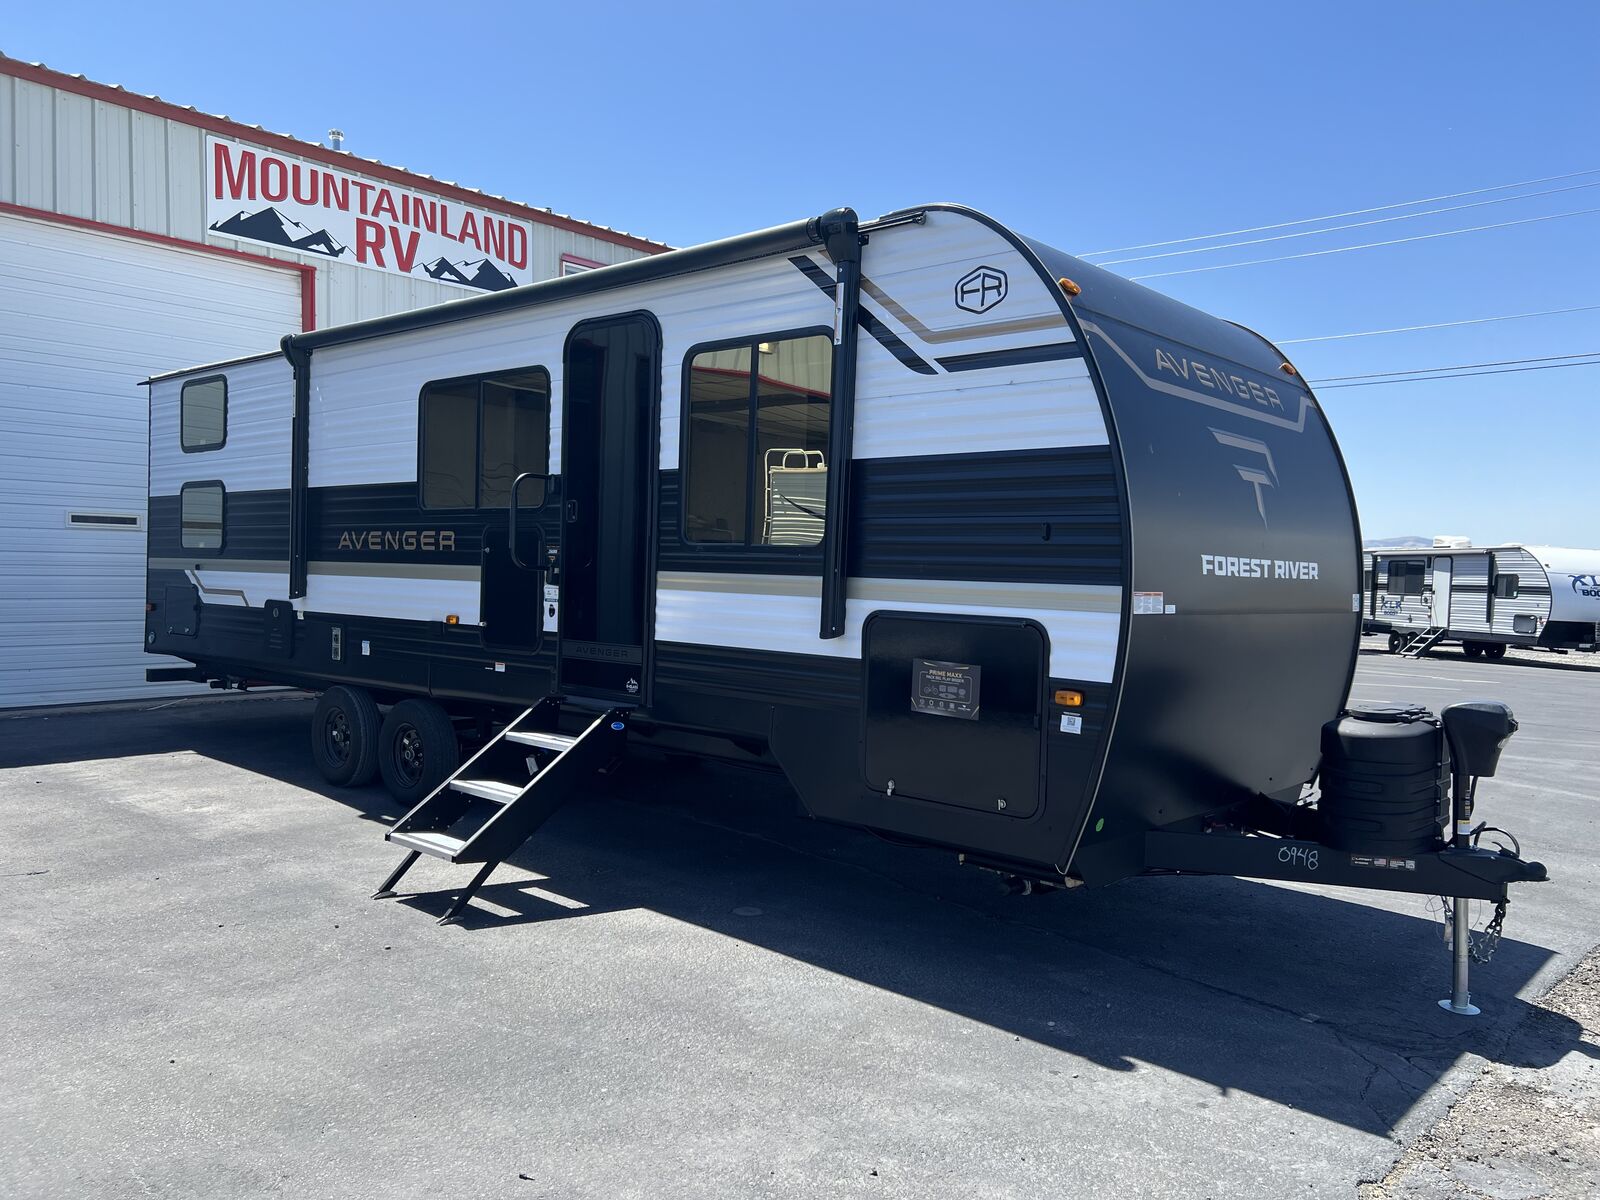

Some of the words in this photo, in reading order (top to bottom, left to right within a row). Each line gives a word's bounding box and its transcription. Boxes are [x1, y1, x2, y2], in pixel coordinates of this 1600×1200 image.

[214, 143, 528, 270] MOUNTAINLAND
[355, 217, 420, 273] RV
[1156, 348, 1284, 411] AVENGER
[338, 530, 455, 551] AVENGER
[1201, 554, 1271, 578] FOREST
[1274, 560, 1318, 580] RIVER
[1568, 575, 1600, 594] XL
[576, 646, 629, 657] AVENGER
[929, 669, 946, 677] PRIME
[946, 671, 963, 679] MAXX
[1278, 847, 1318, 870] 0948
